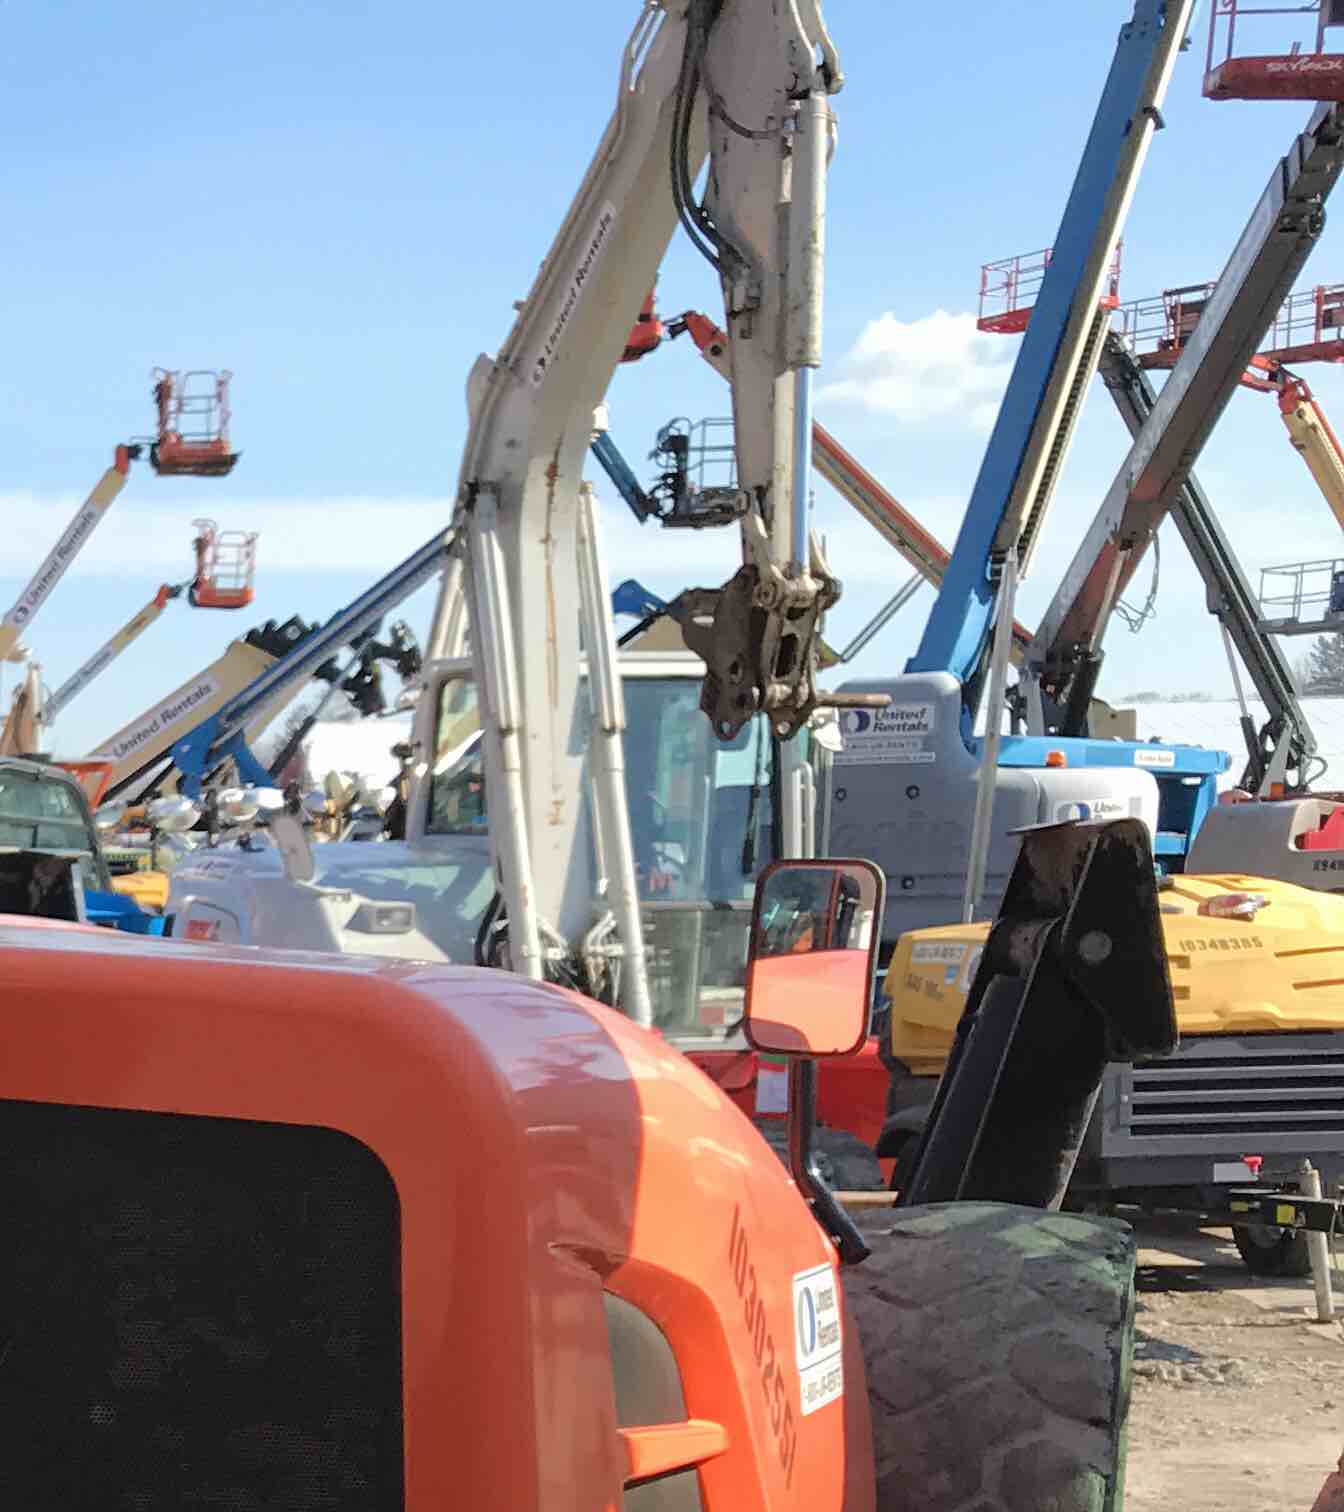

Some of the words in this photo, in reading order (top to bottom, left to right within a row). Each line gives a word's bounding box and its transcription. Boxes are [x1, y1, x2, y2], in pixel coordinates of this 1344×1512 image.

[112, 719, 161, 758] United
[159, 685, 211, 724] Rentals
[728, 1202, 798, 1492] 10302551
